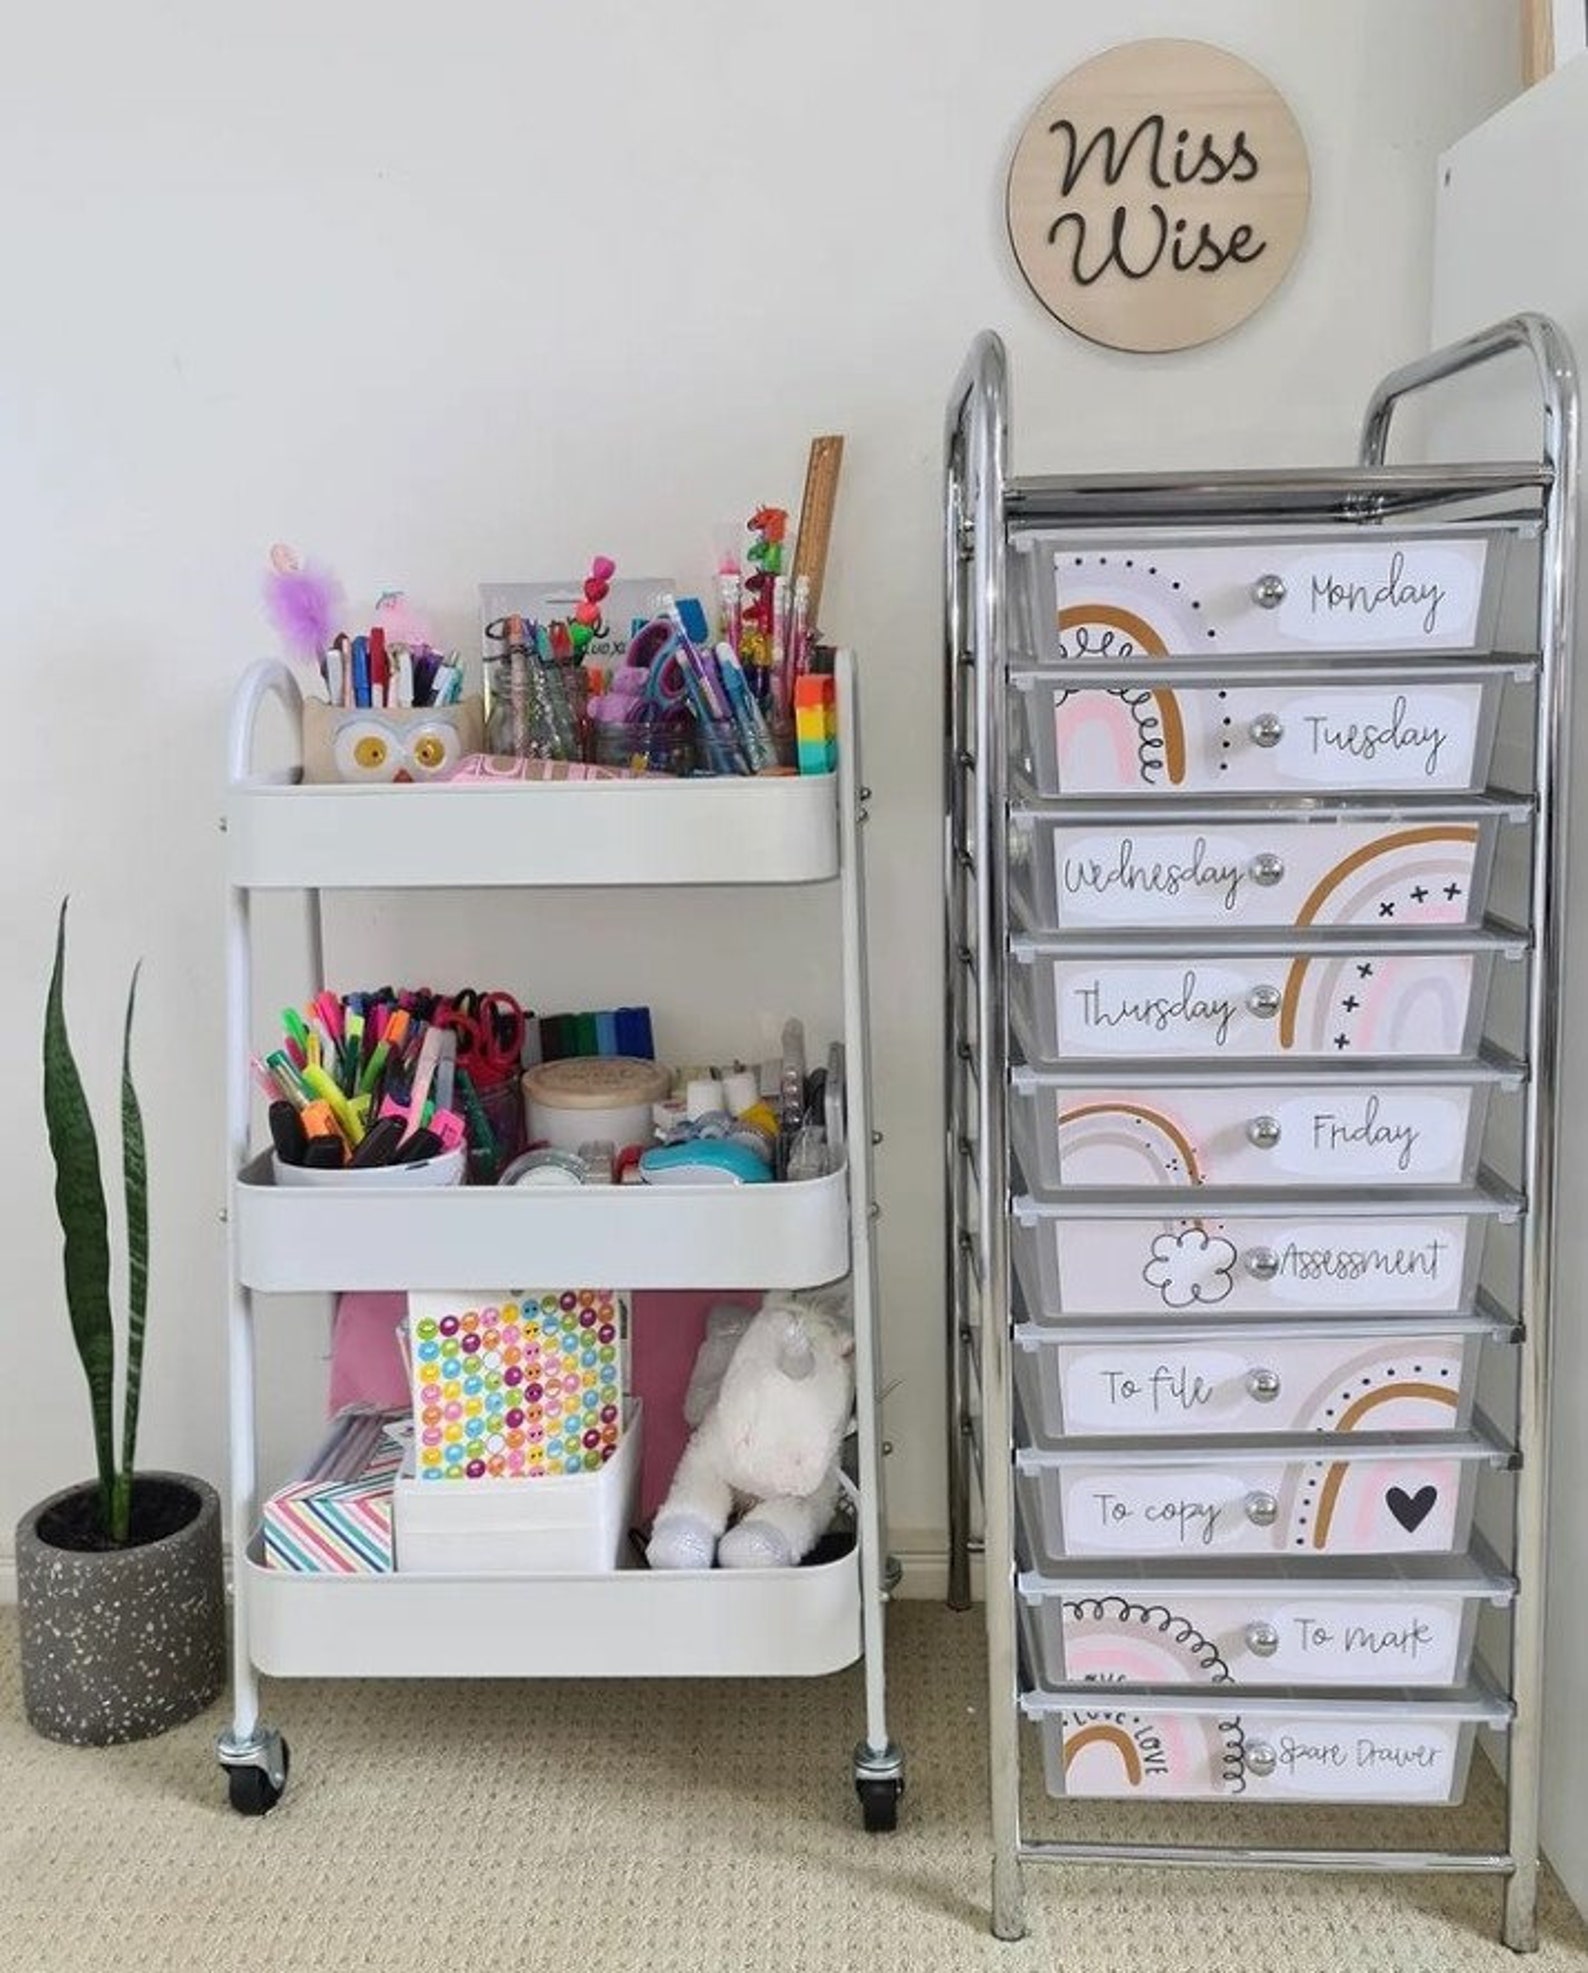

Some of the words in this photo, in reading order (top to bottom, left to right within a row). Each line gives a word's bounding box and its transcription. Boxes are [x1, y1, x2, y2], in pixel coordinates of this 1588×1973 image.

[1049, 115, 1258, 196] Miss
[1048, 204, 1267, 285] Wise
[1310, 551, 1446, 633] Monday
[1303, 696, 1447, 775] Tuesday
[1064, 837, 1246, 910] Wednesday
[1073, 970, 1238, 1046] Thursday
[1312, 1095, 1420, 1170] Friday
[1280, 1238, 1448, 1280] Assessment
[1100, 1371, 1142, 1405] To
[1148, 1365, 1213, 1414] file
[1093, 1494, 1131, 1526] To
[1144, 1501, 1222, 1545] copy
[1293, 1618, 1334, 1652] To
[1345, 1616, 1434, 1659] mark
[1280, 1736, 1347, 1775] Spare
[1357, 1738, 1442, 1768] Drawer
